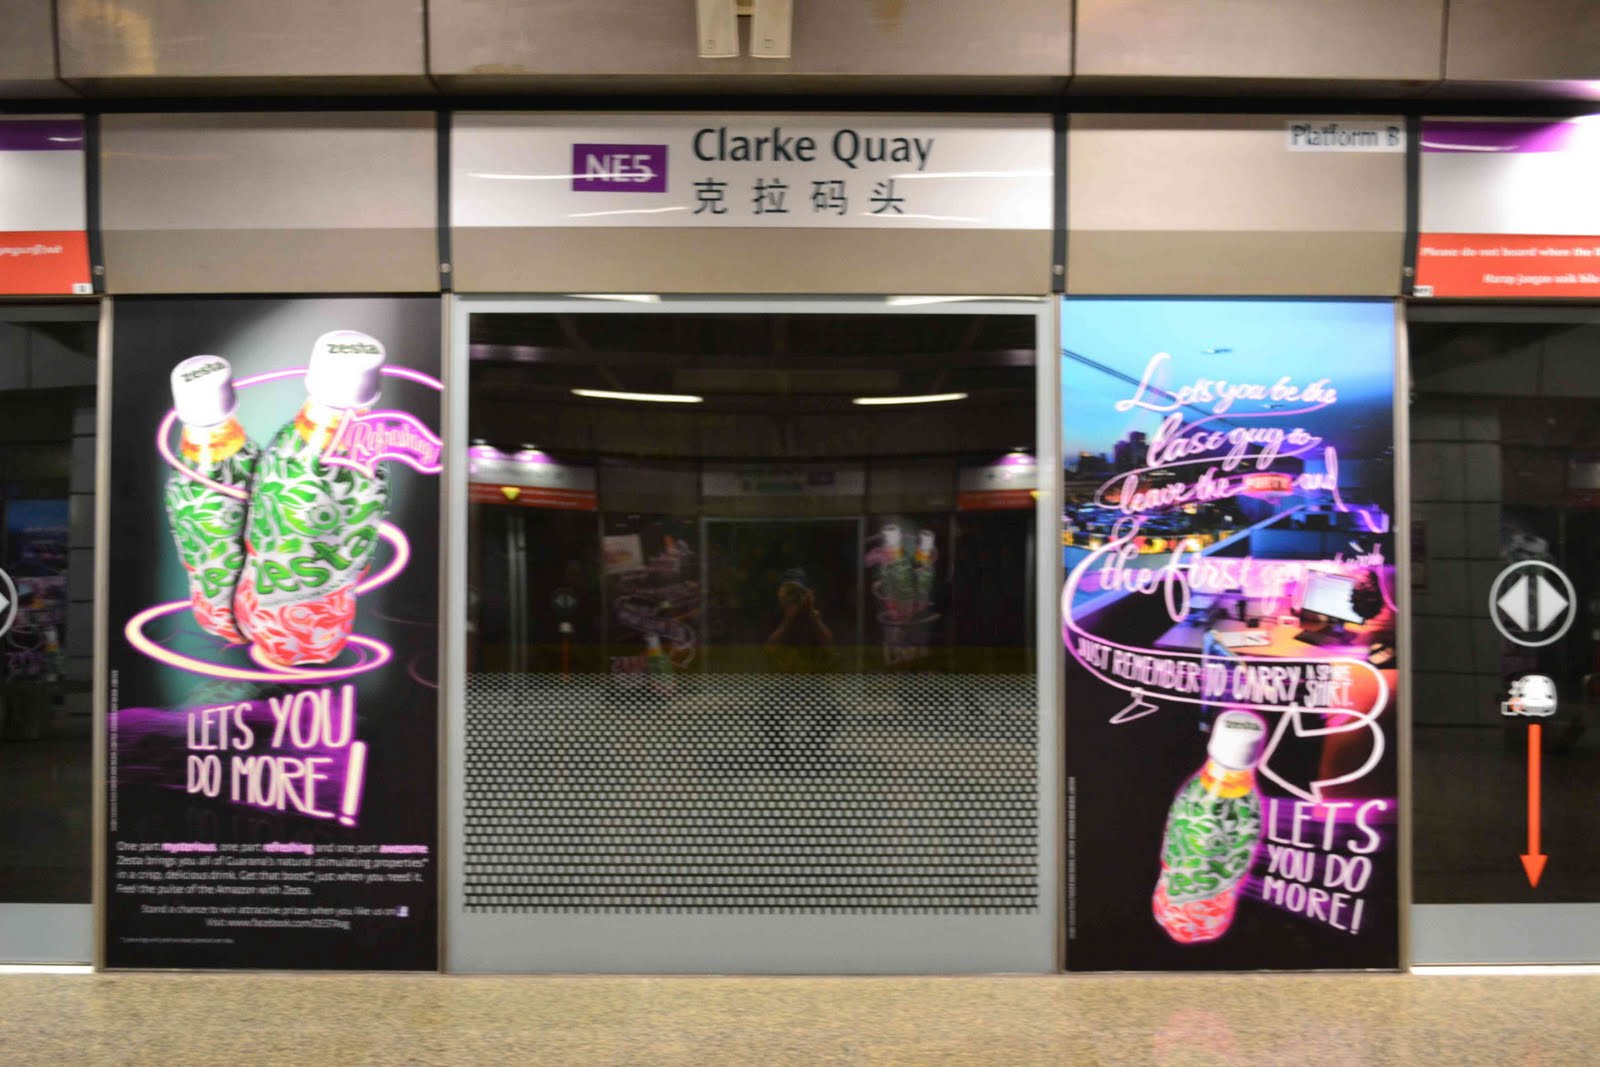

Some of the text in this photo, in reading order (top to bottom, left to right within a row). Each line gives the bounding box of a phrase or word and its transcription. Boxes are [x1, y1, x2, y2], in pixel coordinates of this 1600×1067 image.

[693, 127, 934, 170] Clarke Quay
[1290, 123, 1400, 148] Platform B
[585, 153, 655, 183] NE5
[693, 177, 906, 216] 克拉码头
[1421, 247, 1458, 257] Please
[1462, 247, 1476, 257] do
[1481, 248, 1499, 257] not
[1502, 247, 1538, 257] board
[326, 342, 381, 355] zesta
[181, 361, 226, 383] zesta
[1213, 380, 1267, 414] you
[1270, 376, 1299, 402] be
[1300, 379, 1338, 404] the
[1147, 412, 1226, 467] last
[1222, 427, 1286, 472] guy
[1120, 474, 1186, 514] leave
[1099, 541, 1158, 594] the
[1160, 540, 1252, 623] first
[1077, 637, 1112, 671] JUST
[1111, 649, 1201, 694] REMEMBER
[1232, 664, 1301, 704] CARRY
[187, 684, 354, 750] LETS YOU
[187, 740, 368, 827] DO MORE!
[1268, 798, 1387, 854] LETS
[1267, 844, 1372, 892] YOU DO
[1263, 876, 1364, 934] MORE!
